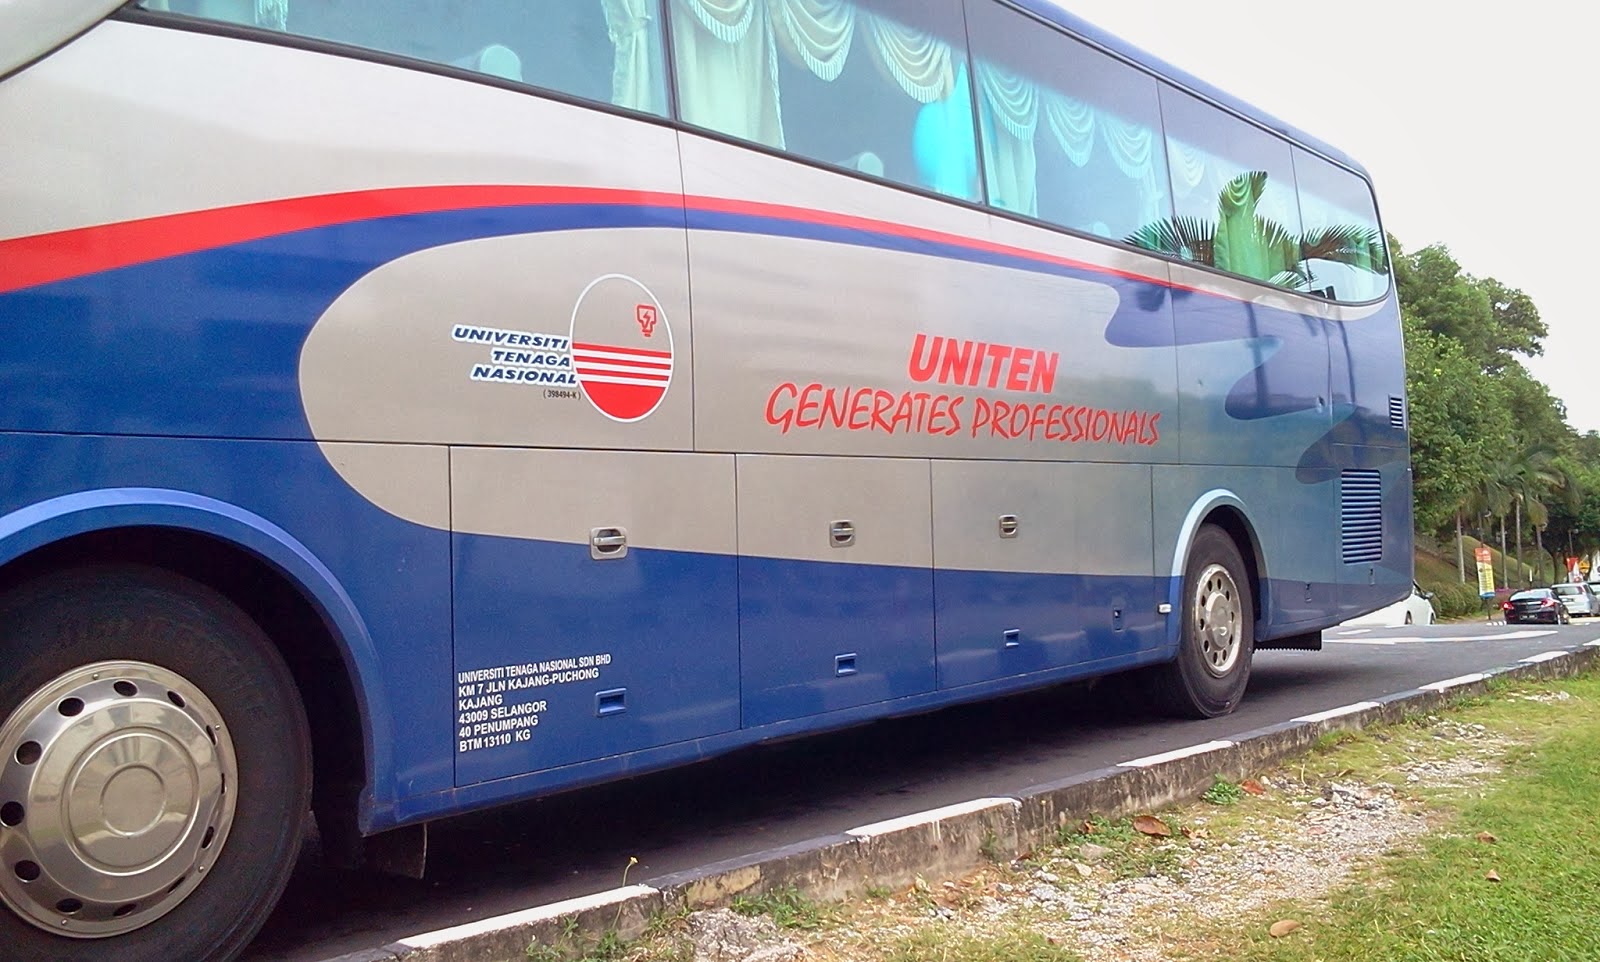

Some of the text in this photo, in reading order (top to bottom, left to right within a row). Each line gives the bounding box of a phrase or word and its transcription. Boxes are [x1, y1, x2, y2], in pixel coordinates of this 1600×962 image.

[454, 327, 569, 349] UNIVERSITI
[493, 351, 570, 367] TENAGA
[908, 333, 1059, 394] UNITEN
[473, 367, 577, 384] NASIONAL
[764, 382, 1161, 446] GENERATES PROFESSIONALS
[458, 653, 611, 684] UNIVERSITI TENAGA NASIONAL SDN BHD
[458, 668, 599, 697] KM 7 JLN KAJANG-PUCHONG
[458, 694, 503, 711] KAJANG
[459, 700, 547, 724] 43009 SELANGOR
[459, 714, 538, 738] 40 PENUMPANG
[459, 729, 531, 752] BTM 13110 KG
